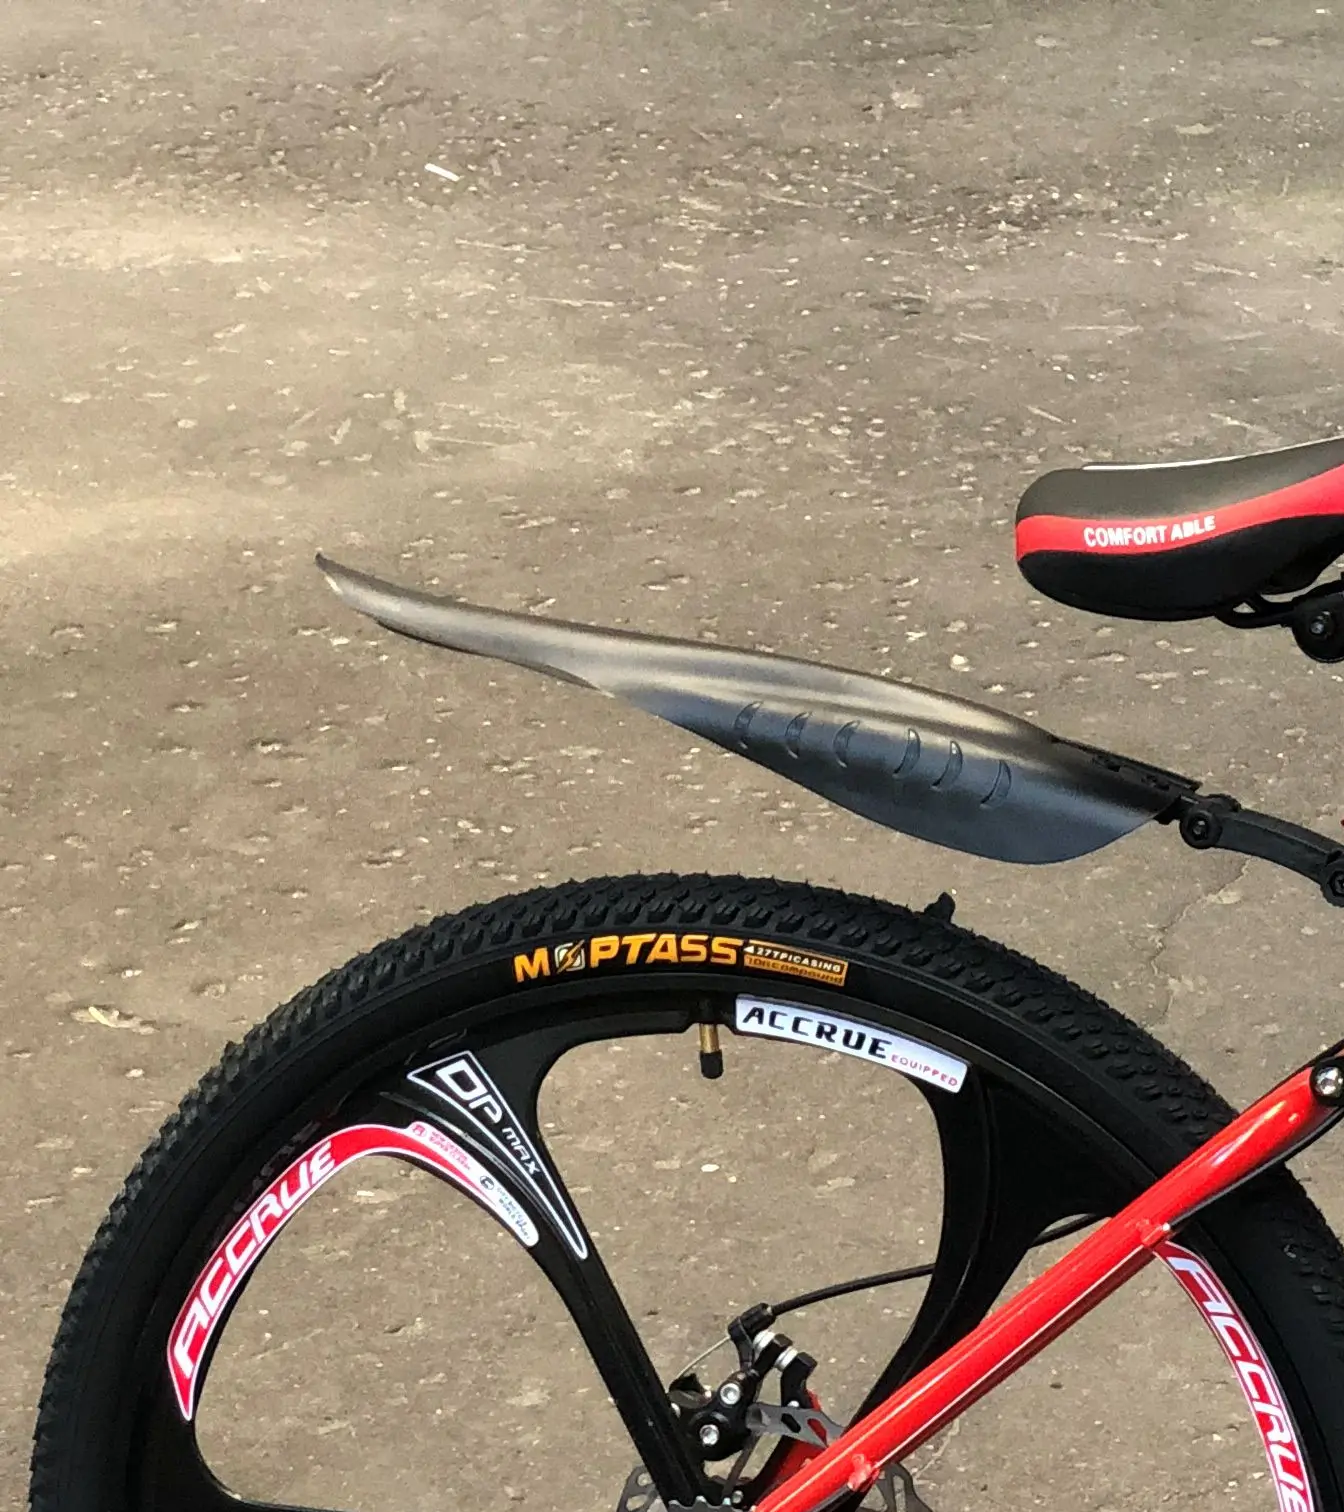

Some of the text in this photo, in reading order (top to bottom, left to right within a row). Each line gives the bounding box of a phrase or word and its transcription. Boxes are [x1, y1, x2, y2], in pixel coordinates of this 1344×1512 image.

[742, 1006, 958, 1087] ACCRUE EQUIPPED
[173, 1139, 336, 1380] ACCRUE
